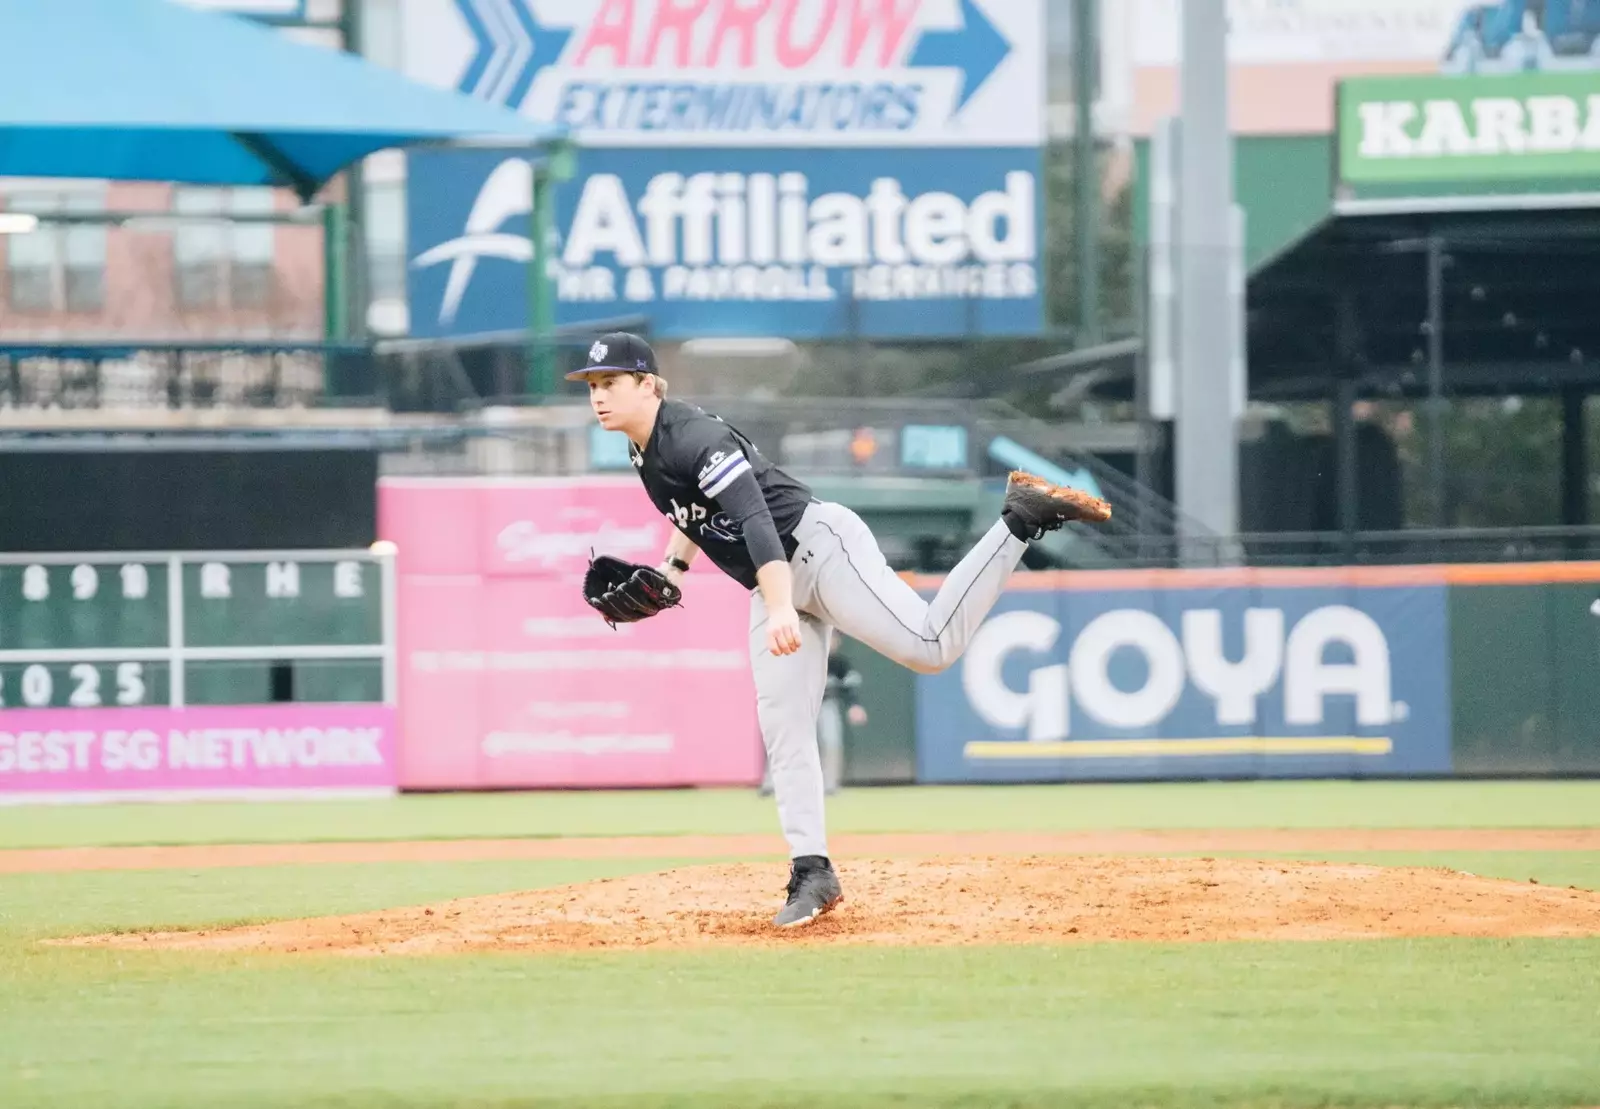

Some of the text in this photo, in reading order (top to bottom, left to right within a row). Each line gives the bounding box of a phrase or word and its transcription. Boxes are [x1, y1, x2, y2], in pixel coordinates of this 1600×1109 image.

[570, 0, 922, 68] ARROW
[555, 81, 925, 132] EXTERMINATORS
[1357, 94, 1600, 158] KARB
[565, 170, 1035, 266] Affiliated
[23, 564, 49, 601] 8
[71, 563, 98, 600] 9
[201, 563, 231, 597] R
[334, 561, 363, 596] E
[963, 605, 1392, 741] GOYA
[102, 730, 162, 769] 5G
[168, 728, 383, 768] NETWORK
